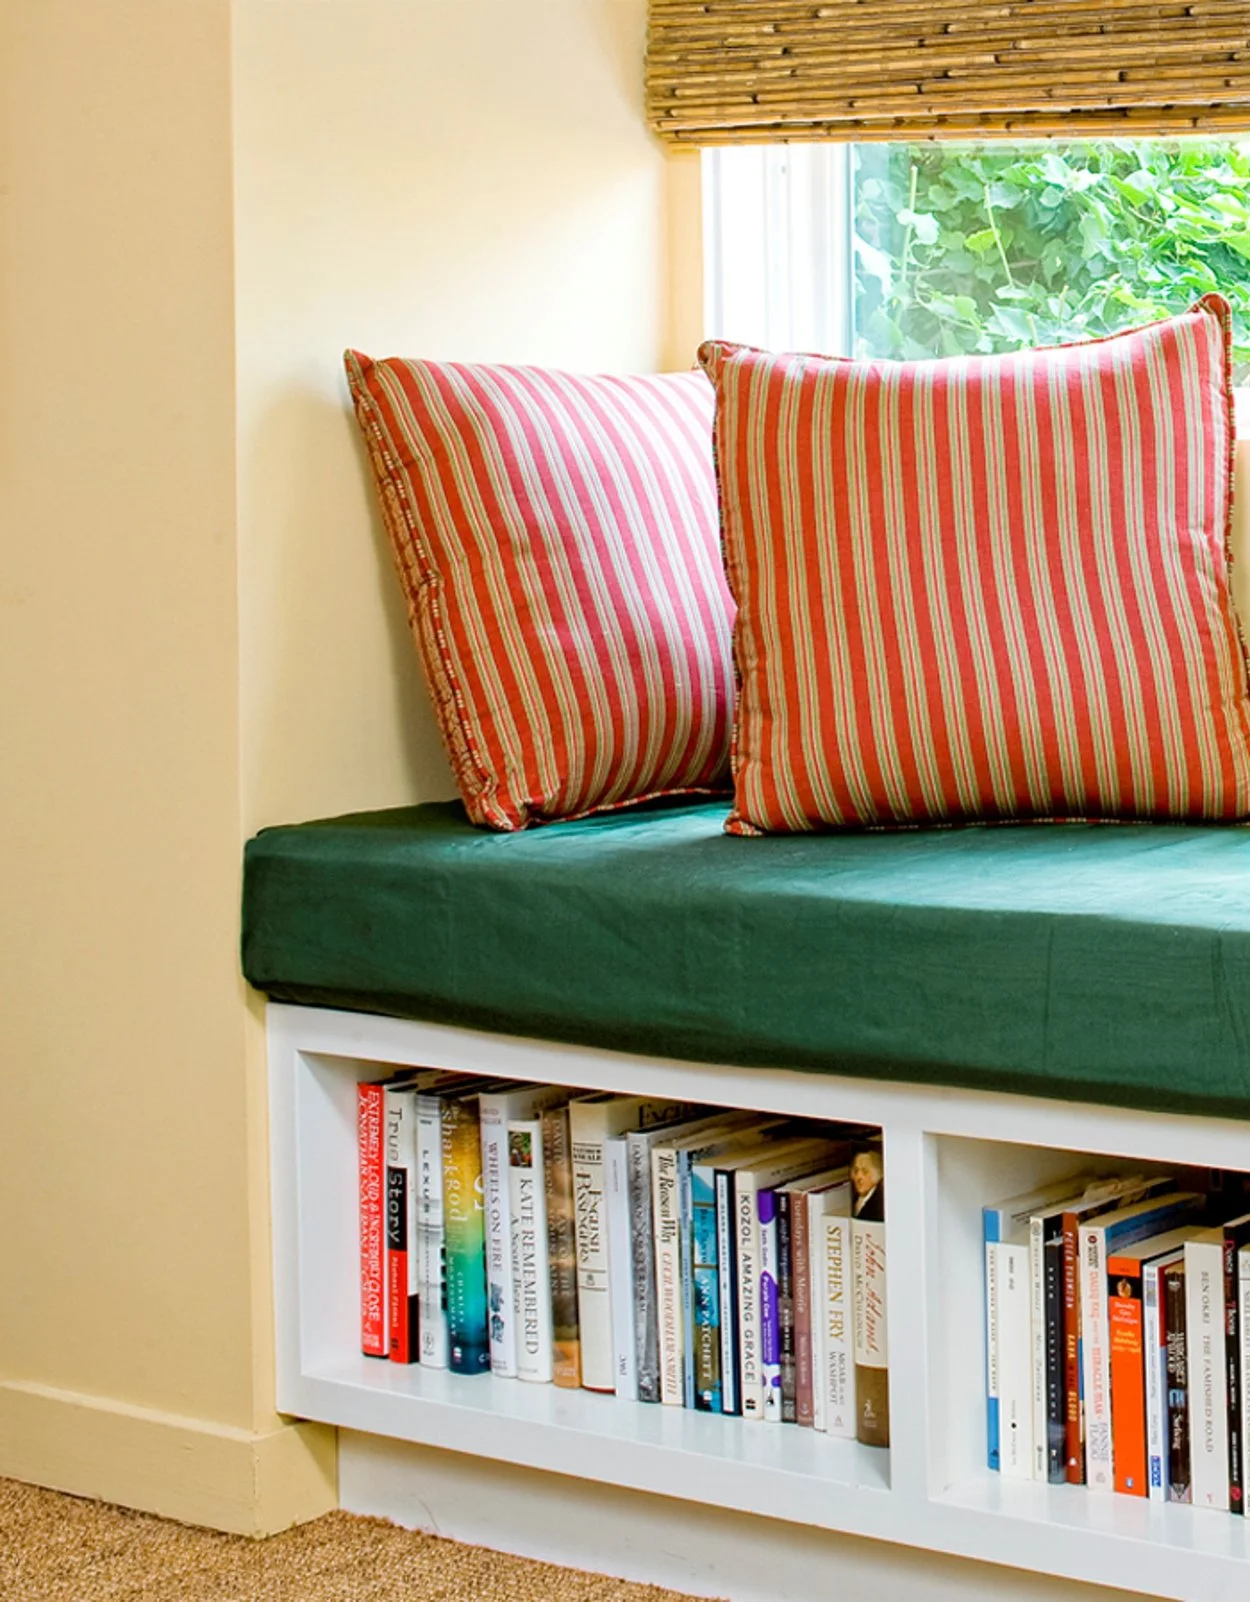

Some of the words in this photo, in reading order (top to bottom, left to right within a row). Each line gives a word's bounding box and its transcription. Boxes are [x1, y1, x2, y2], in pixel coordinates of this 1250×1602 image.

[368, 1091, 381, 1162] EXTREMELY
[389, 1108, 403, 1162] True
[368, 1166, 381, 1201] LOUD
[488, 1142, 501, 1207] WHEELS
[659, 1154, 676, 1173] The
[388, 1172, 403, 1244] Story
[519, 1178, 533, 1225] KATE
[659, 1177, 676, 1217] Reason
[740, 1194, 753, 1245] KOZOL
[489, 1209, 502, 1233] ON
[588, 1190, 604, 1253] ENGLISH
[660, 1219, 678, 1243] Why
[794, 1200, 807, 1245] tuesdays
[491, 1239, 504, 1272] FIRE
[795, 1249, 807, 1273] with
[826, 1226, 843, 1302] STEPHEN
[865, 1233, 886, 1279] John
[1064, 1231, 1074, 1261] PETER
[368, 1279, 382, 1321] CLOSE
[521, 1230, 541, 1355] REMEMBERED
[700, 1277, 711, 1307] ANN
[742, 1253, 757, 1322] AMAZING
[796, 1277, 809, 1313] Morrie
[829, 1311, 845, 1343] FRY
[865, 1283, 884, 1355] Adams
[702, 1310, 713, 1379] PATCHETT
[744, 1329, 757, 1380] GRACE
[1067, 1334, 1078, 1359] KAVA
[1174, 1331, 1186, 1385] MARGARET
[829, 1351, 839, 1404] WASHPOT
[1203, 1358, 1214, 1417] FAMISHED
[1068, 1391, 1079, 1422] BLOOD
[1205, 1420, 1215, 1453] ROAD
